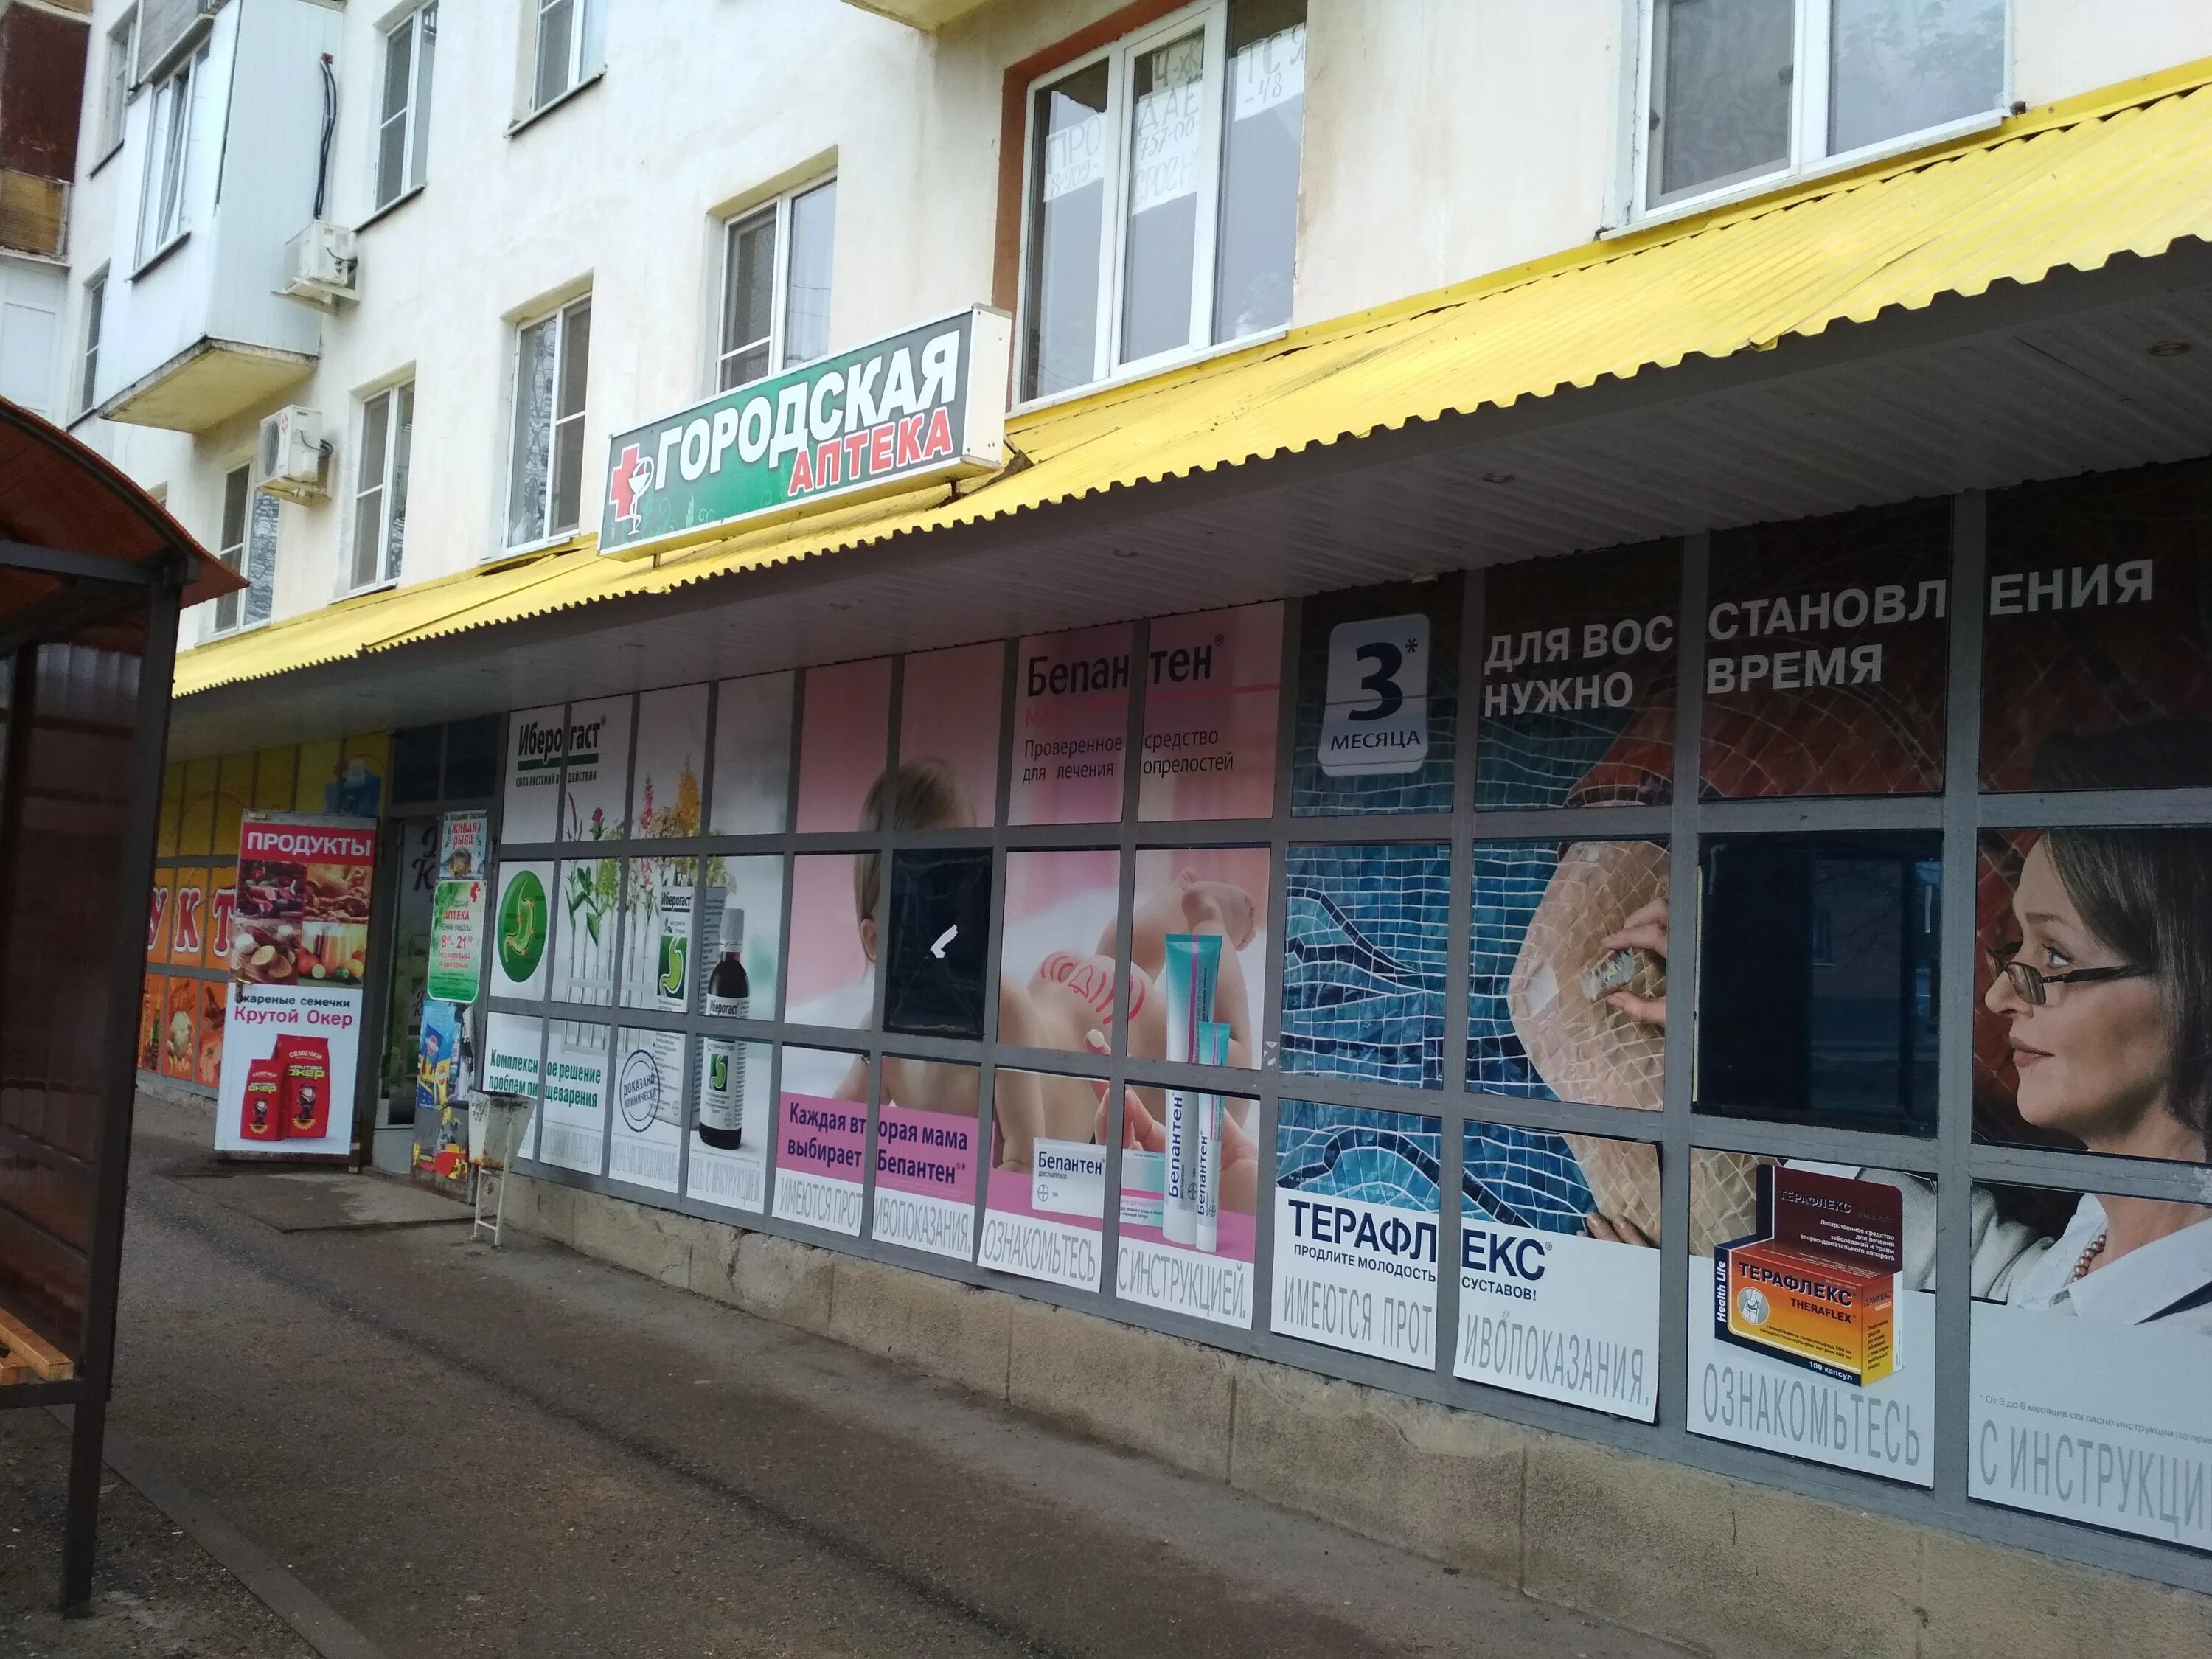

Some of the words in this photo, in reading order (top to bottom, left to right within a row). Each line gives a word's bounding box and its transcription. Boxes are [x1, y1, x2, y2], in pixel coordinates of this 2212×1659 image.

[654, 330, 960, 490] ГОРОДСКАЯ
[787, 406, 953, 496] АПТЕКА
[1484, 627, 1570, 675] ДЛЯ
[1484, 672, 1633, 717] НУЖНО
[1706, 643, 1882, 695] ВРЕМЯ
[1024, 736, 1123, 759] Проверенное
[1144, 729, 1219, 752] средство
[1330, 730, 1421, 751] МЕСЯЦА
[1022, 765, 1046, 785] для
[1056, 762, 1114, 779] лечения
[1143, 751, 1234, 778] опрелостей
[247, 832, 372, 857] ПРОДУКТЫ
[443, 910, 470, 921] АПТЕКА
[661, 891, 691, 909] Иберогаст
[240, 994, 296, 1006] жареные
[301, 997, 350, 1008] семечки
[234, 1006, 299, 1024] Крутой
[307, 1009, 353, 1029] Окер
[559, 1063, 601, 1085] решение
[622, 1072, 655, 1098] ДОКАЗАНО
[623, 1089, 658, 1110] КЛИНИЧЕСКИ
[790, 1102, 846, 1133] Каждая
[922, 1127, 967, 1150] мама
[787, 1137, 862, 1167] выбирает
[1038, 1151, 1102, 1175] Бепантен
[1168, 1096, 1183, 1199] Бепантен
[779, 1178, 832, 1222] ИМЕЮТСЯ
[1781, 1190, 1852, 1214] ТЕРАФЛЕКС
[1820, 1219, 1865, 1234] Лекарственное
[1865, 1229, 1895, 1242] средство
[984, 1217, 1096, 1283] ОЗНАКОМЬТЕСЬ
[1118, 1246, 1129, 1291] С
[1130, 1249, 1247, 1318] ИНСТРУКЦИЕЙ.
[1293, 1243, 1355, 1267] ПРОДЛИТЕ
[1357, 1256, 1436, 1282] МОЛОДОСТЬ
[1461, 1276, 1537, 1301] СУСТАВОВ!
[1717, 1260, 1727, 1282] Life
[1739, 1262, 1854, 1308] ТЕРАФЛЕКС
[1284, 1276, 1371, 1341] ИМЕЮТСЯ
[1717, 1283, 1728, 1324] Health
[1790, 1298, 1852, 1324] THERAFLEX
[1809, 1360, 1823, 1371] 100
[1824, 1367, 1853, 1381] капсул
[1703, 1363, 1920, 1467] ОЗНАКОМЬТЕСЬ
[1985, 1395, 1997, 1405] От
[2006, 1400, 2018, 1410] до
[2028, 1404, 2068, 1419] месяцев
[2070, 1412, 2115, 1427] согласно
[2116, 1421, 2174, 1438] инструкции
[1980, 1419, 1997, 1485] С
[2011, 1426, 2212, 1538] ИНСТРУКЦИ
